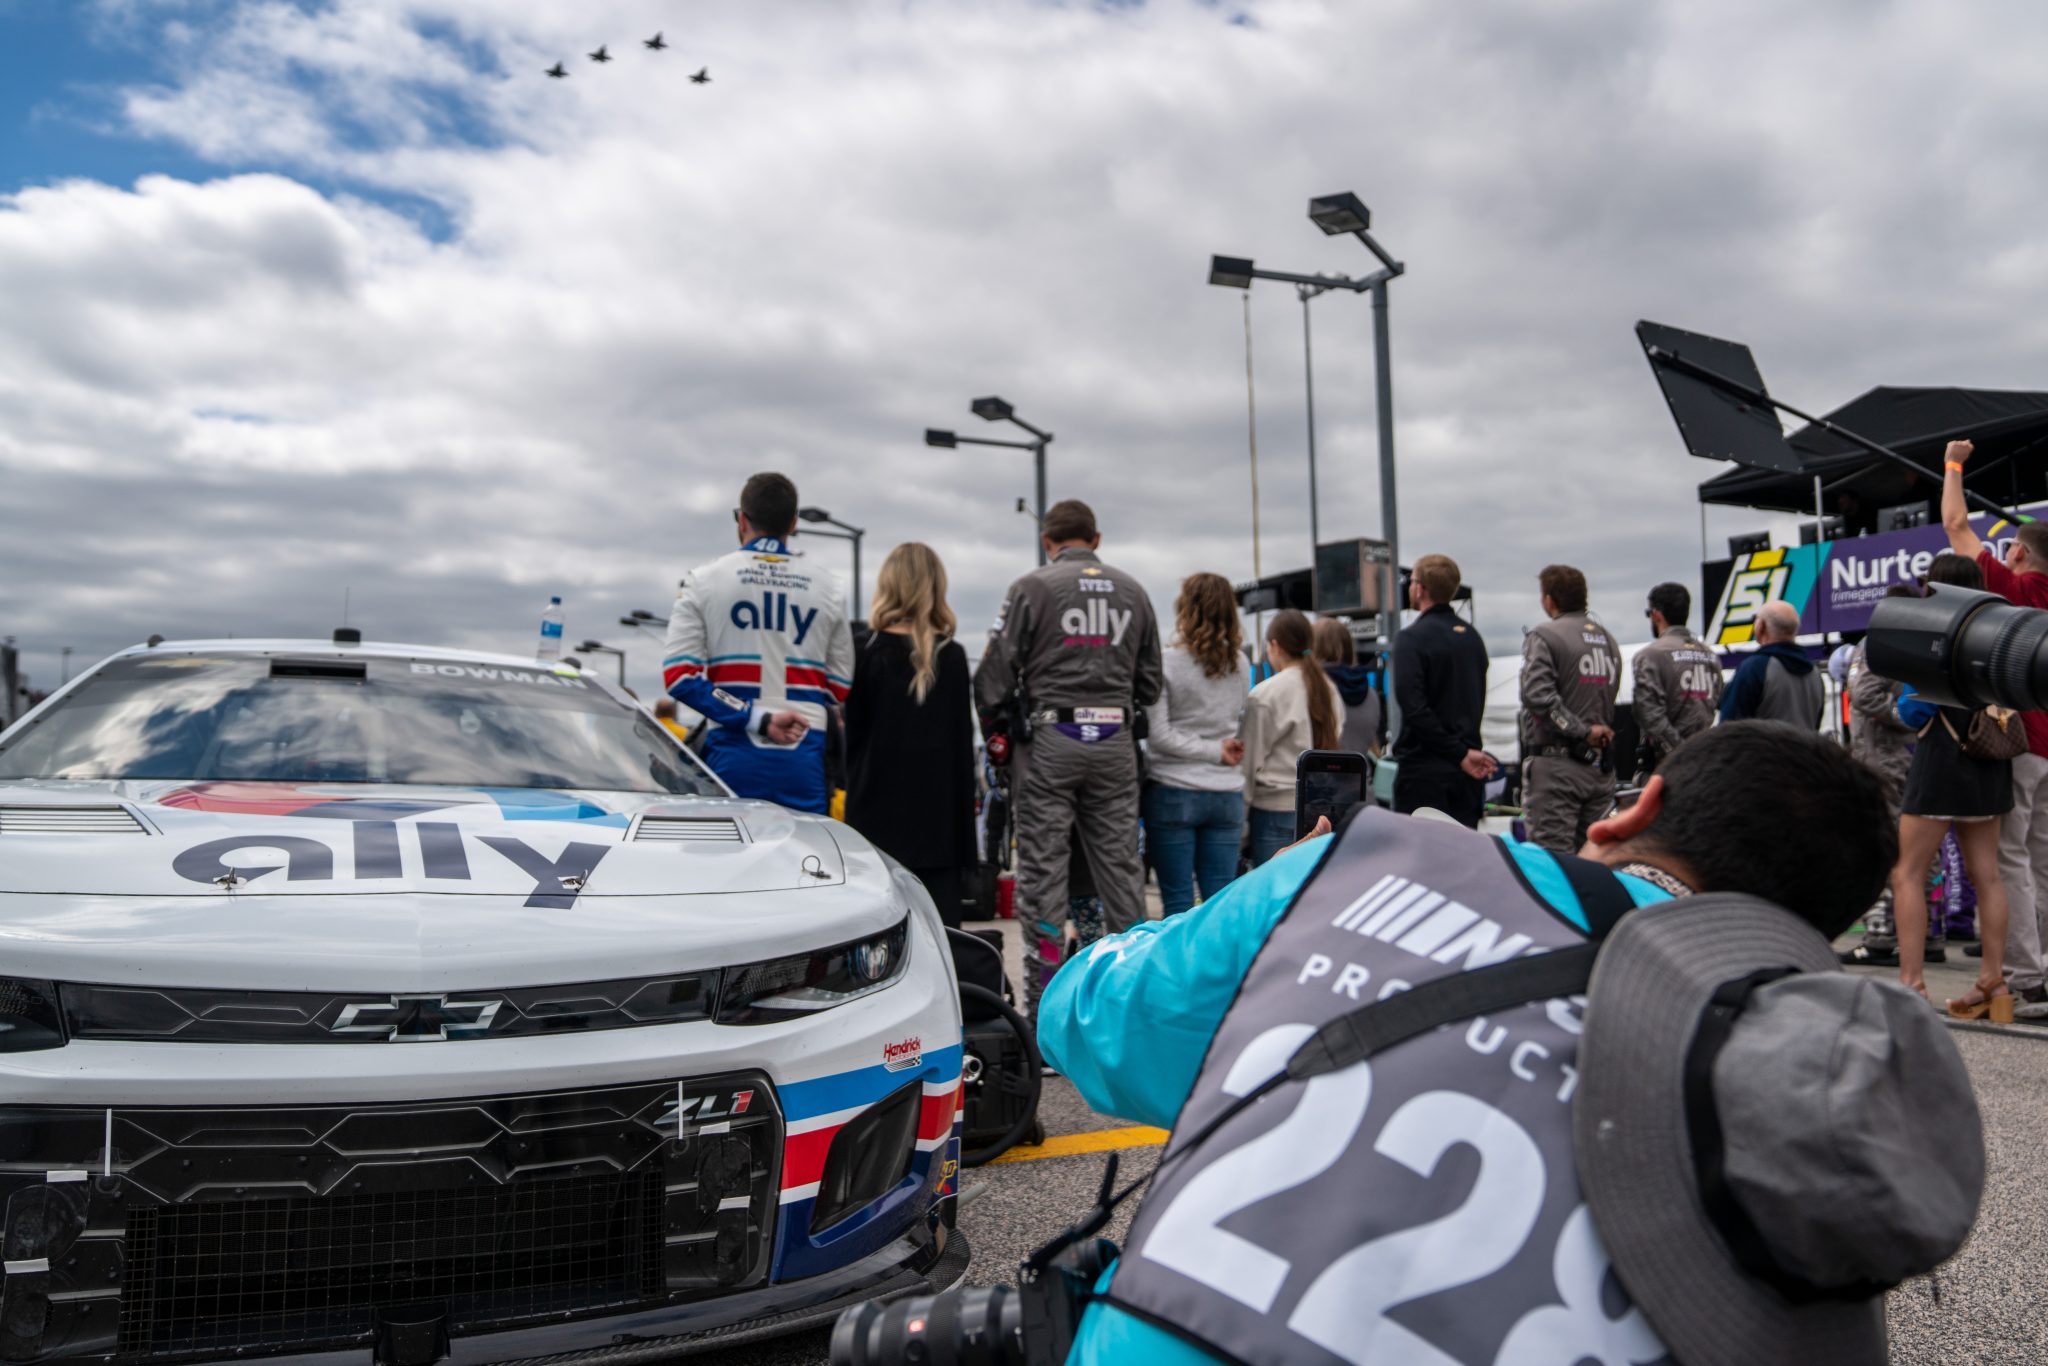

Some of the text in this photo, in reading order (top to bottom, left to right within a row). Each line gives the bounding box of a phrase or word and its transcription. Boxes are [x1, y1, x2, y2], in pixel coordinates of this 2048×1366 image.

[1079, 578, 1114, 592] IVES
[1831, 546, 1955, 590] Nurte
[1725, 566, 1790, 622] 51
[1831, 586, 1888, 603] (rimegepa
[731, 591, 819, 646] ally
[1061, 598, 1132, 646] ally
[409, 663, 588, 689] BOWMAN
[1579, 647, 1618, 685] ally
[1680, 664, 1718, 699] ally
[172, 820, 611, 910] ally
[883, 1037, 921, 1062] Hendrick
[653, 1090, 754, 1125] ZL1
